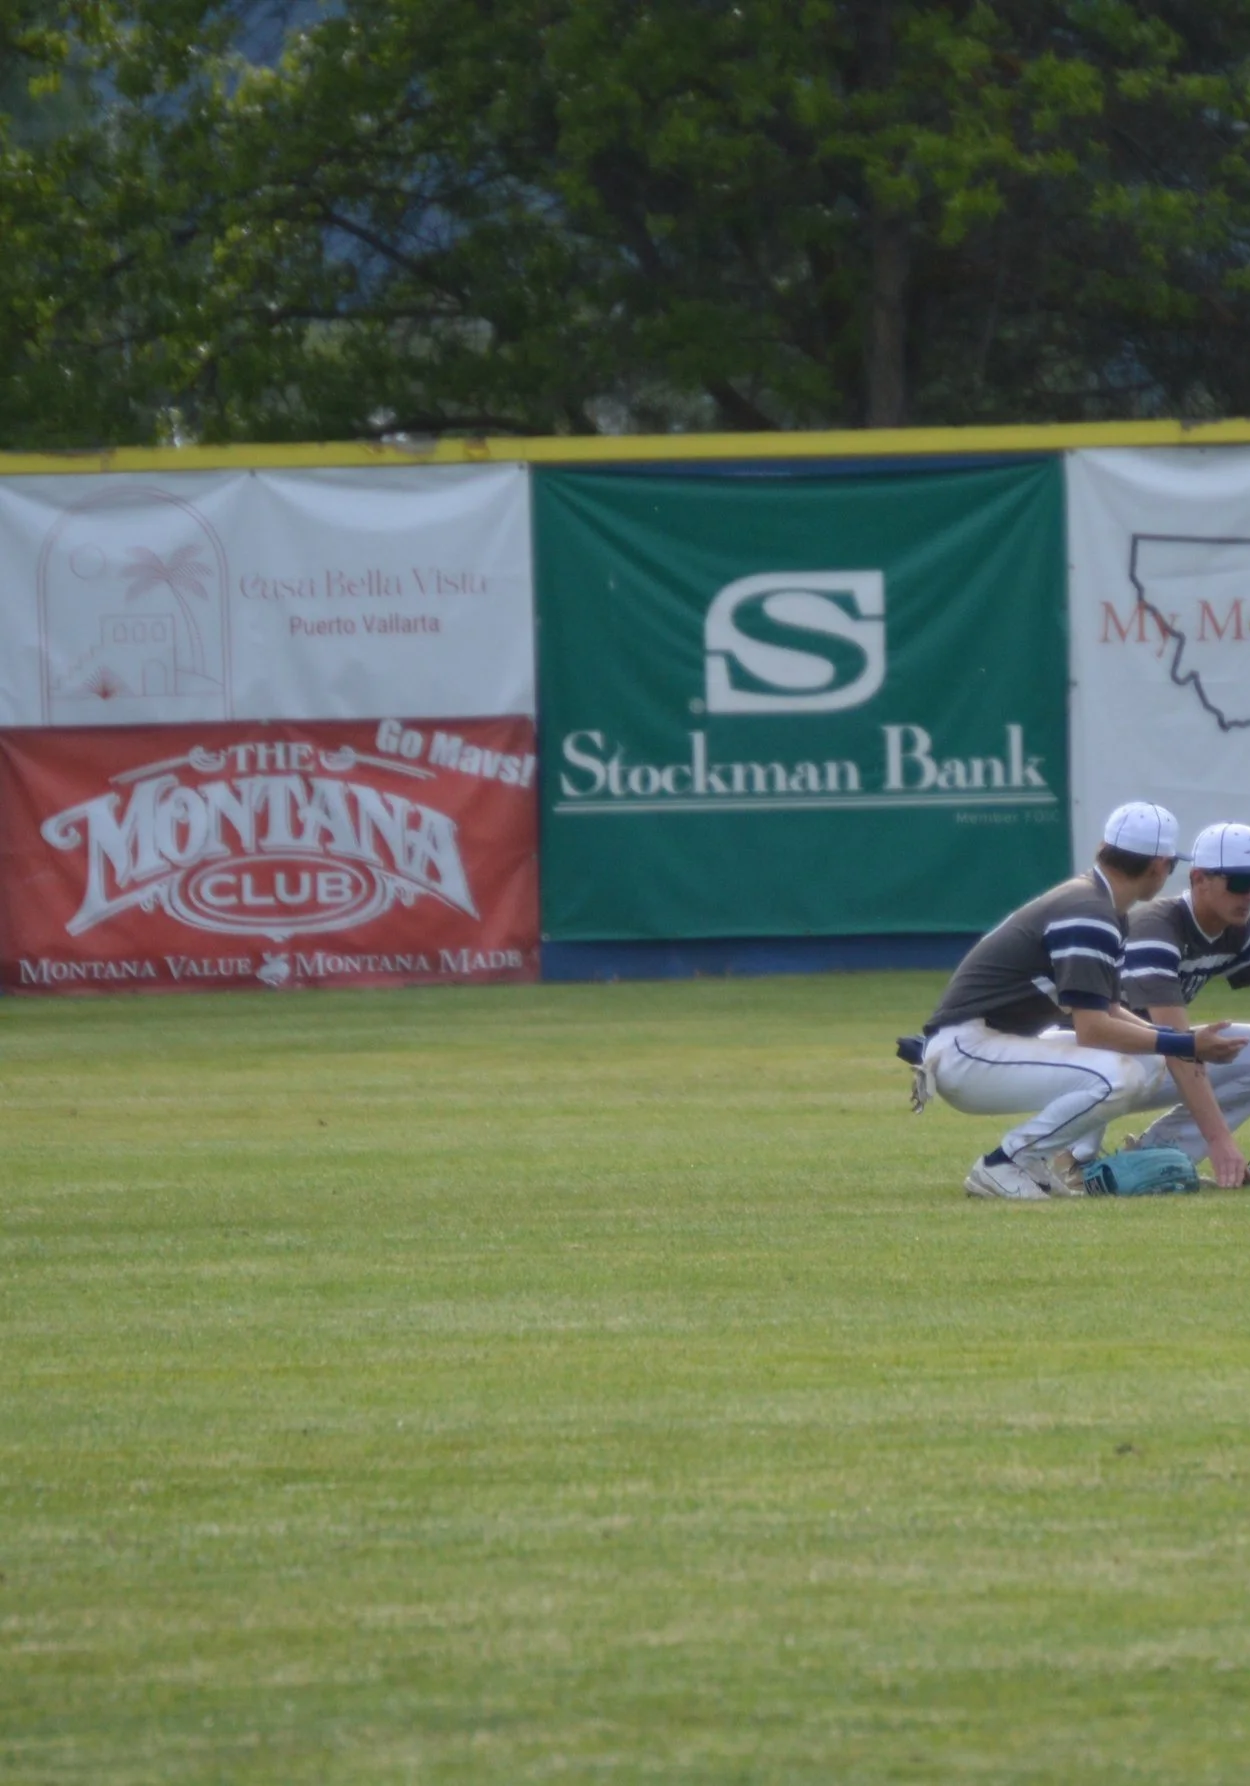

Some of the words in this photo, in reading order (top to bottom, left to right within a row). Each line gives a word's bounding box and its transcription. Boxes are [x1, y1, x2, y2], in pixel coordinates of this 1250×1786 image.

[239, 572, 316, 600] Casa
[325, 568, 402, 598] Bella
[412, 567, 489, 595] Vista
[289, 615, 356, 637] Puerto
[362, 612, 441, 635] Vallarta
[1099, 600, 1179, 658] My
[225, 741, 316, 774] THE
[375, 717, 425, 759] Go
[428, 731, 536, 788] Mavs!
[560, 729, 861, 797] Stockman
[882, 723, 1047, 790] Bank
[41, 774, 481, 936] MONTANA
[200, 872, 354, 906] CLUB
